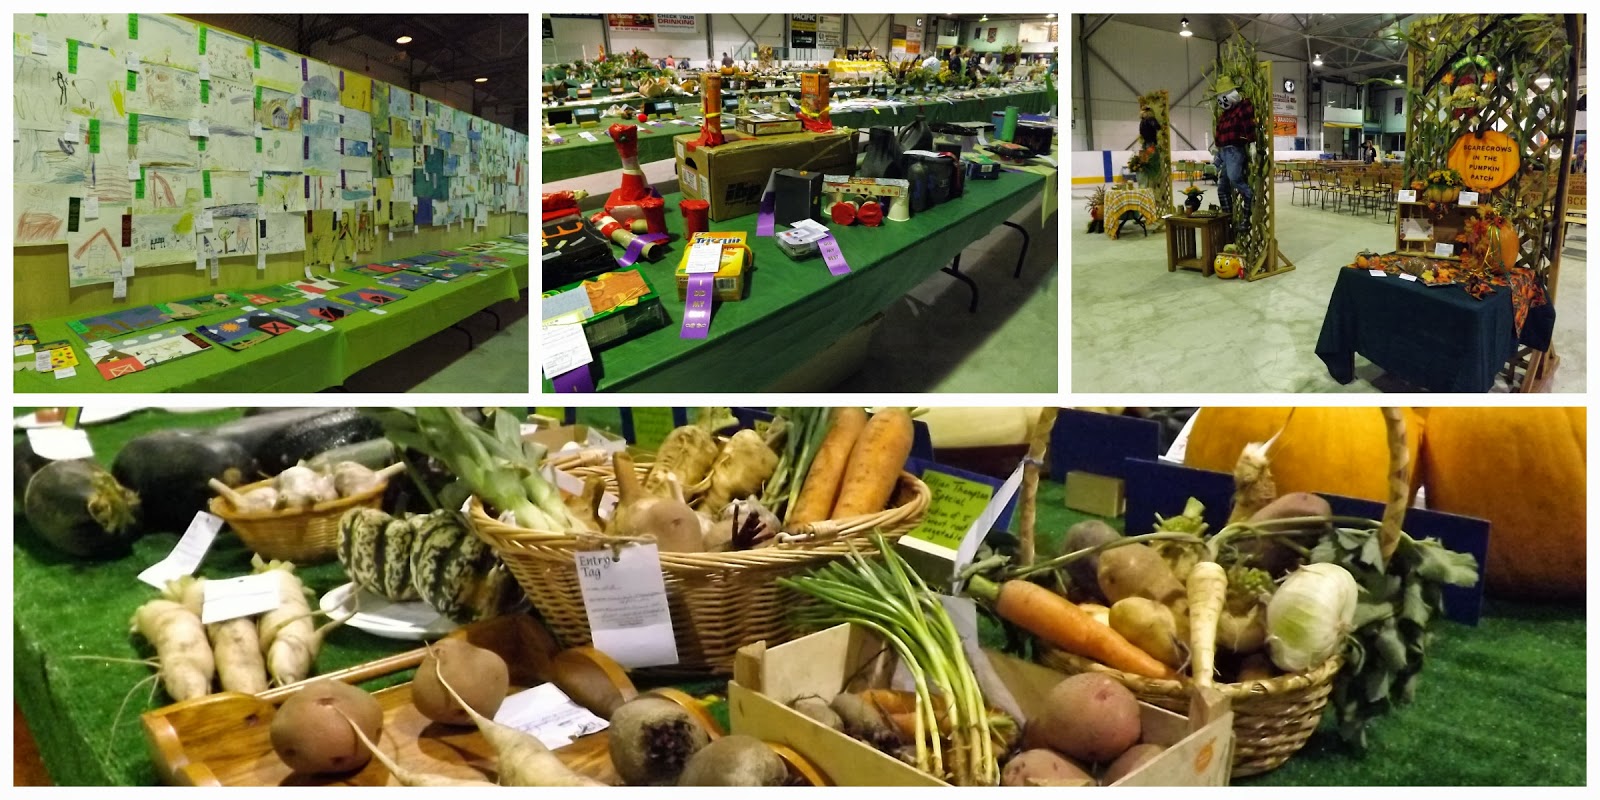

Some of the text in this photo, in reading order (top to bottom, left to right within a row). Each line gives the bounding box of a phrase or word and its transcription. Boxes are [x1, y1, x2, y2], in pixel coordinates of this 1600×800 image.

[1463, 144, 1512, 153] SCARECROWS
[1469, 164, 1500, 172] PUMPKIN
[579, 555, 611, 569] Entry
[580, 567, 601, 580] Tag
